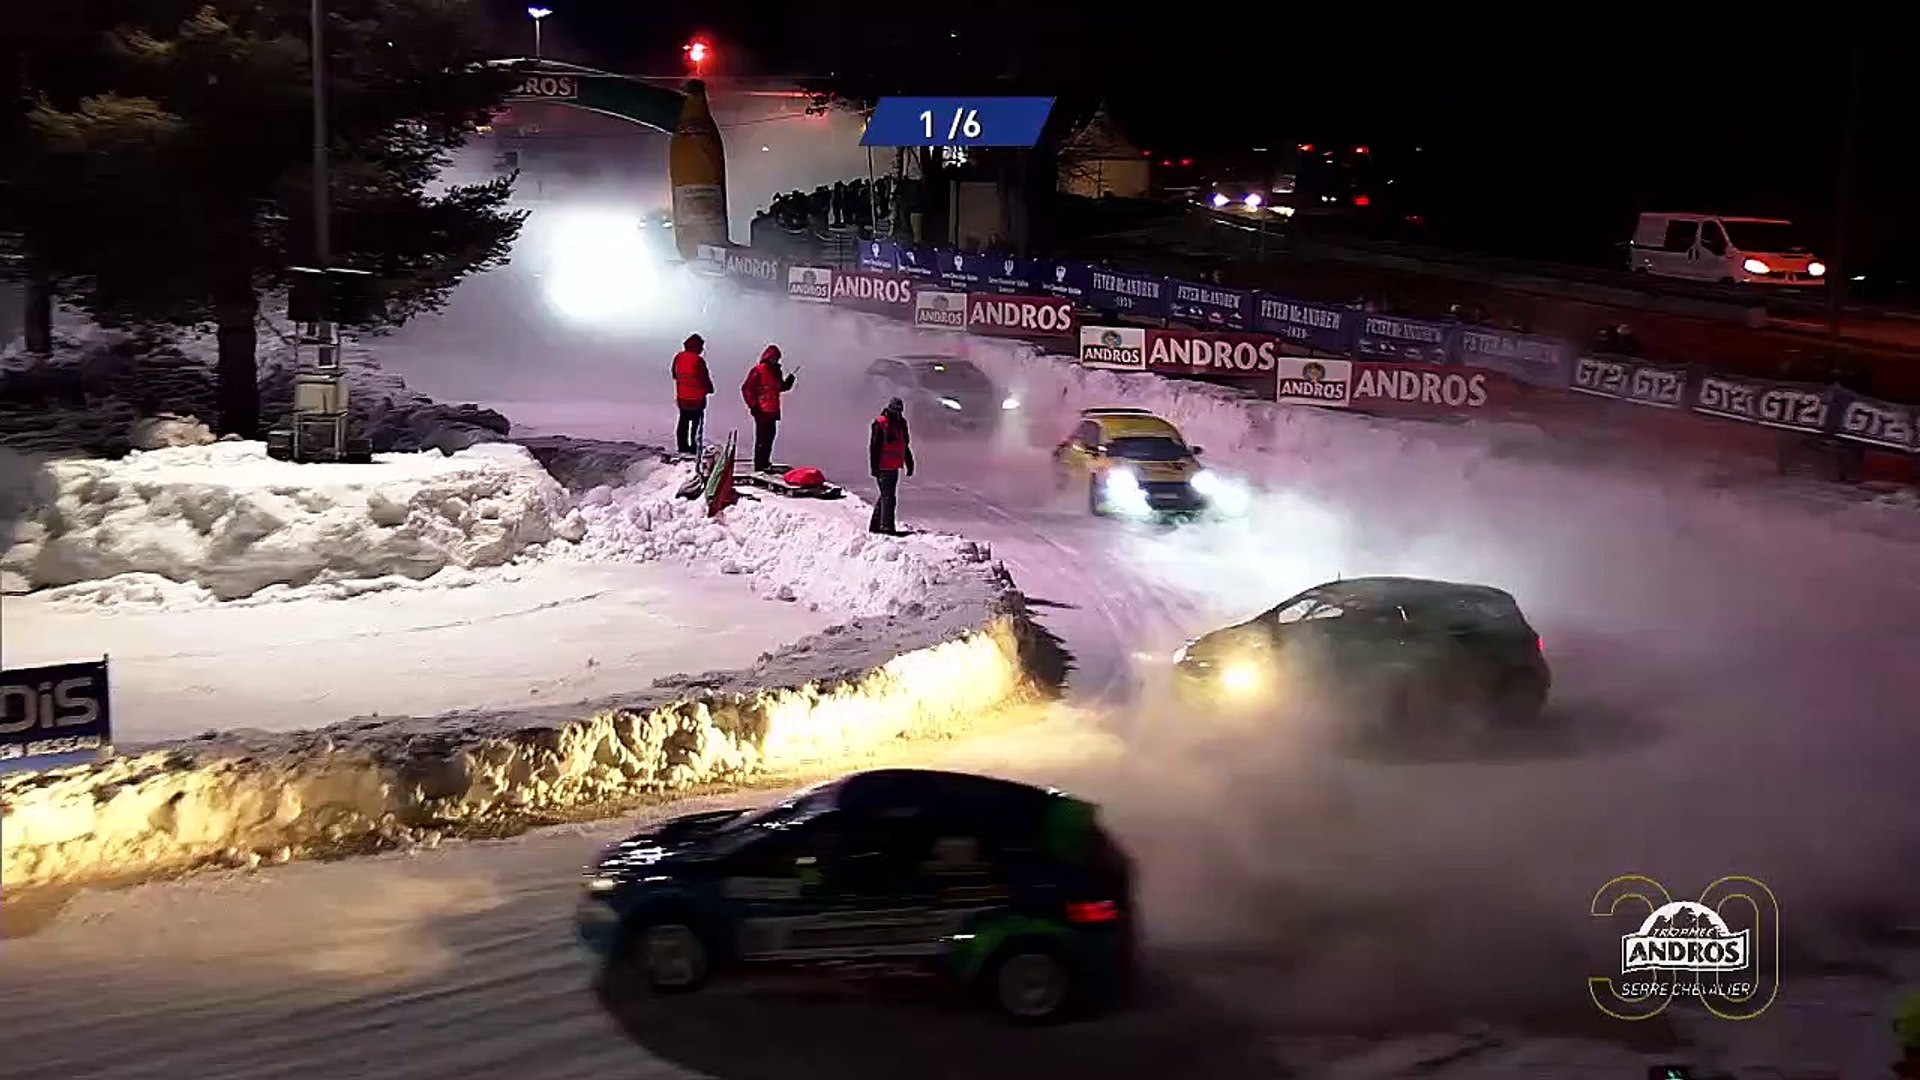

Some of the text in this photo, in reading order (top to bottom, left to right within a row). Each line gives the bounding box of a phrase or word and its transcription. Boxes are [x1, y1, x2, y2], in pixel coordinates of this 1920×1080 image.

[727, 254, 778, 281] ANDROS
[790, 283, 828, 298] ANDROS
[832, 275, 912, 304] ANDROS
[919, 308, 963, 326] ANDROS
[968, 301, 1072, 332] ANDROS
[1084, 347, 1140, 364] ANDROS
[1149, 337, 1275, 371] ANDROS
[1281, 380, 1344, 400] ANDROS
[1352, 369, 1488, 408] ANDROS
